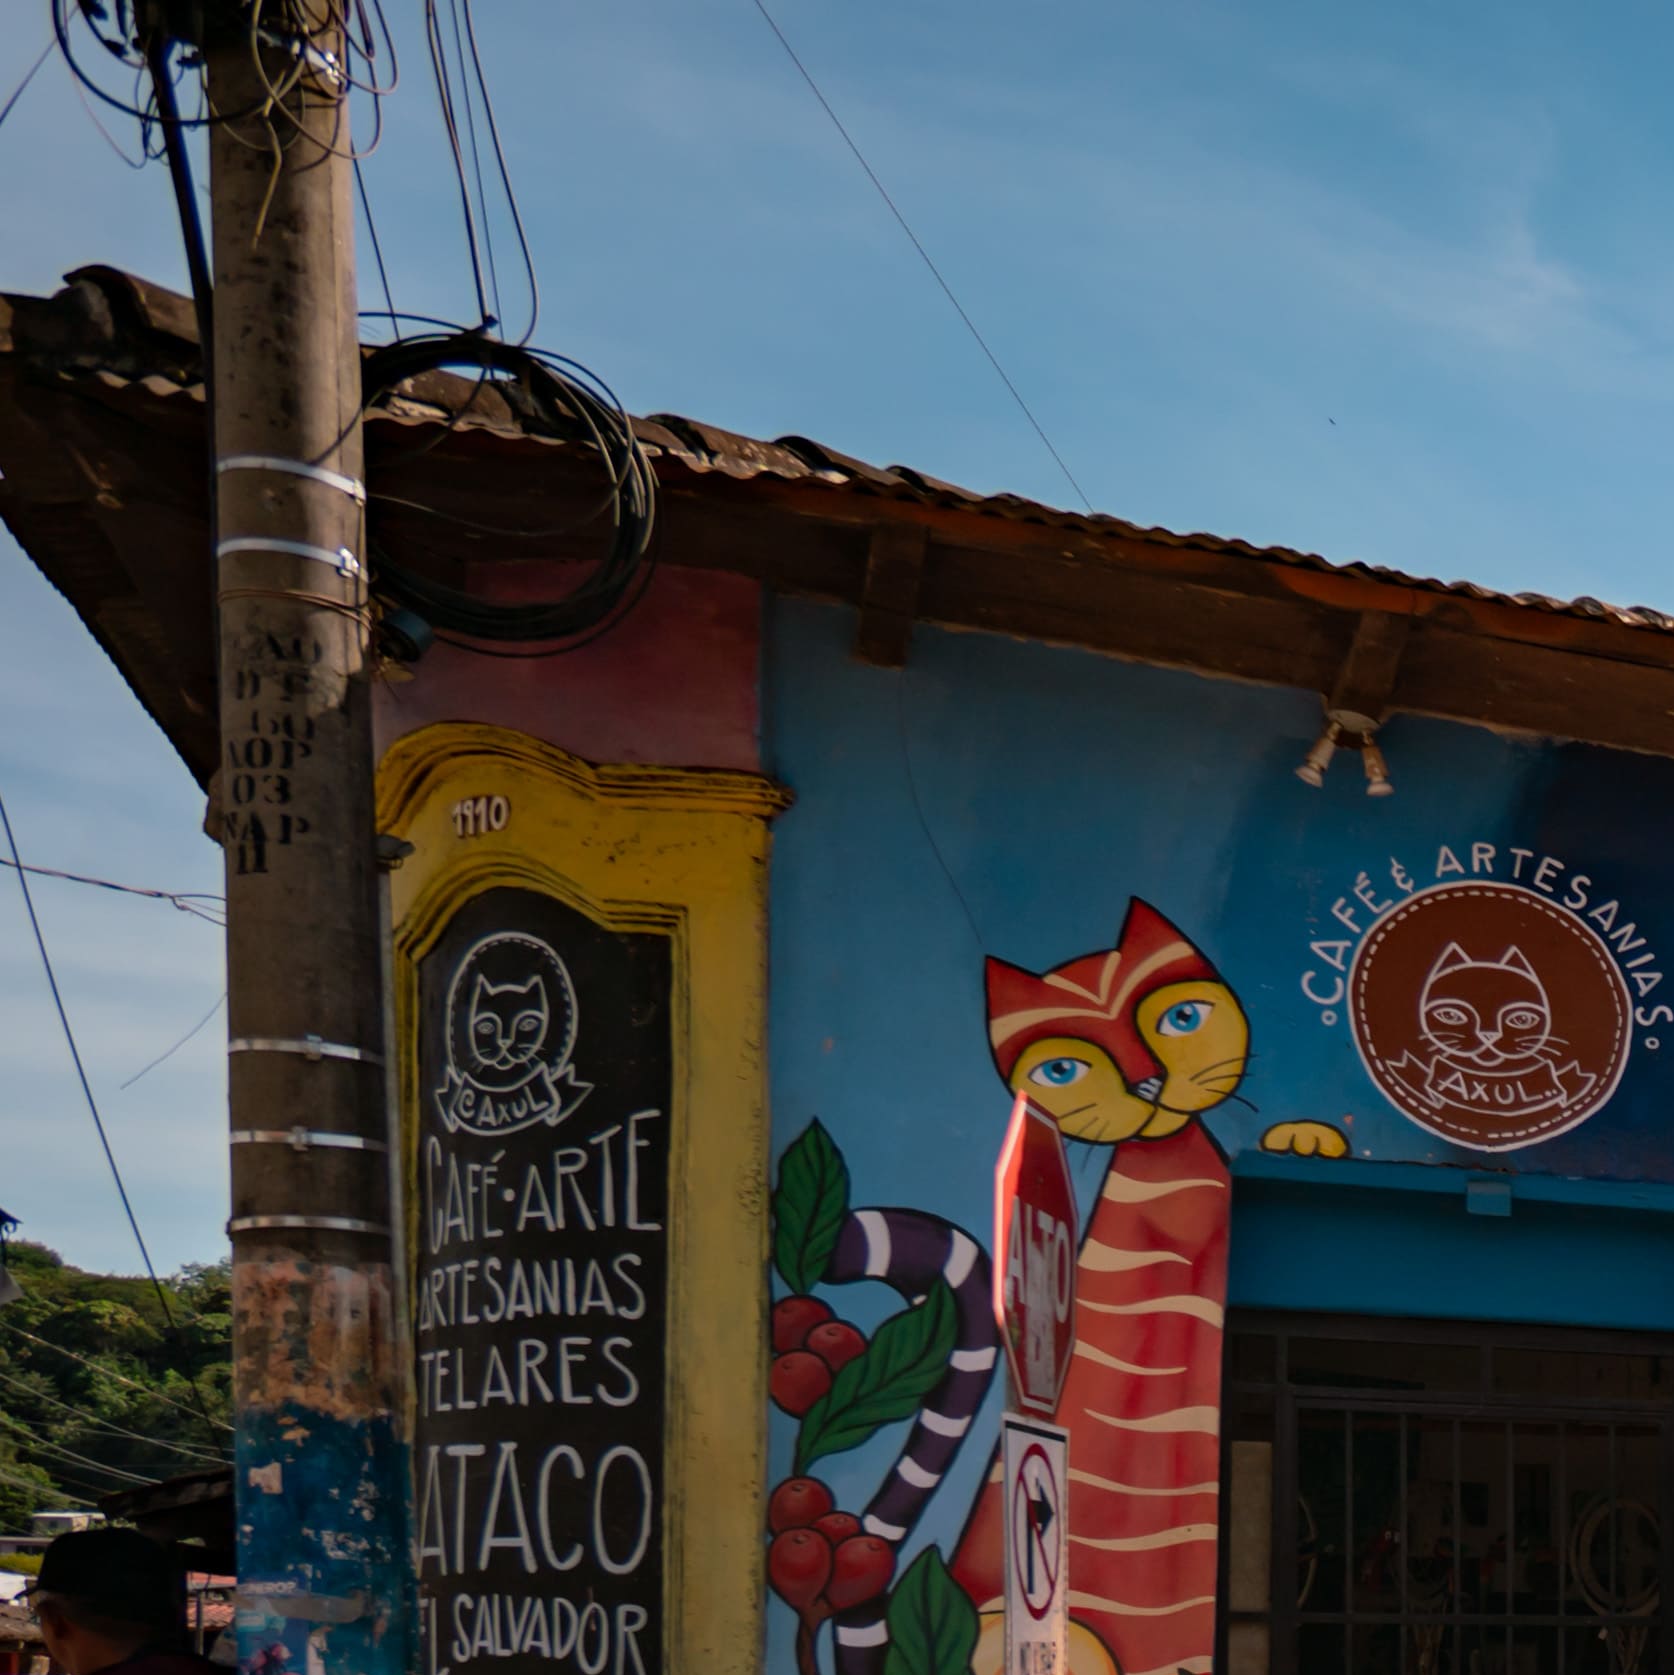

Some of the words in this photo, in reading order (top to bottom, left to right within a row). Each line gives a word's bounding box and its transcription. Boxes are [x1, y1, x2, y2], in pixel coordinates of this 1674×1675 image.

[451, 795, 511, 837] 1910
[1435, 842, 1674, 1027] ARTESANIAS
[516, 1109, 662, 1232] ARTE
[419, 1252, 646, 1335] ARTESANIAS
[1005, 1195, 1071, 1325] ALTO
[420, 1337, 640, 1417] TELARES
[417, 1441, 652, 1577] ATACO
